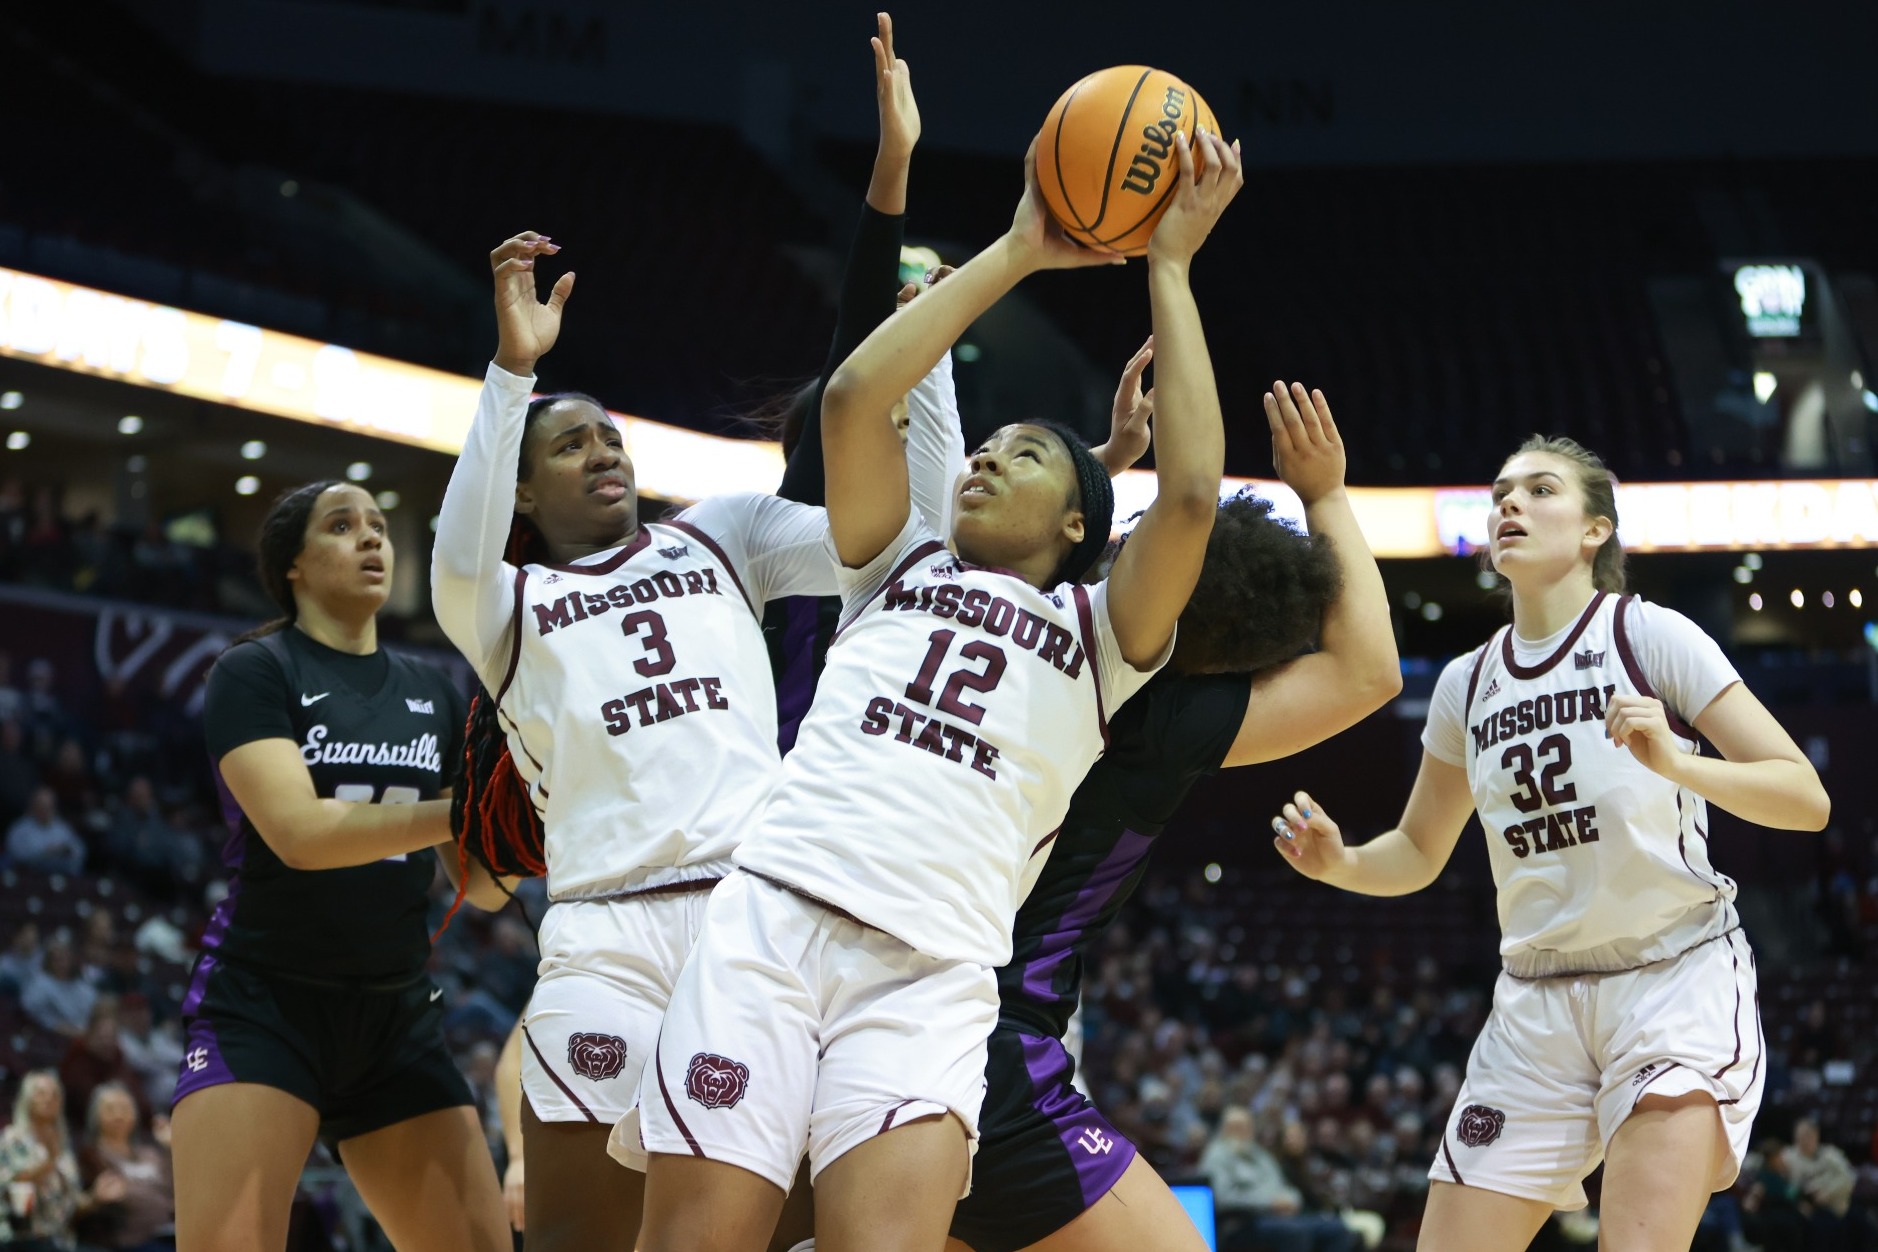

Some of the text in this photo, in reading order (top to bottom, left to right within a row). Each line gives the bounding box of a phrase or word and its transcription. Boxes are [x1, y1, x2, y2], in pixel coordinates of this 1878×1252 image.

[1120, 86, 1186, 195] Wilson
[532, 568, 723, 637] MISSOURI
[882, 580, 1085, 680] MISSOURI
[621, 609, 676, 678] 3
[904, 629, 1008, 726] 12
[601, 677, 728, 736] STATE
[860, 696, 1000, 781] STATE
[1471, 684, 1616, 758] MISSOURI
[300, 724, 441, 773] Evansville
[1501, 733, 1577, 814] 32
[1503, 806, 1600, 858] STATE
